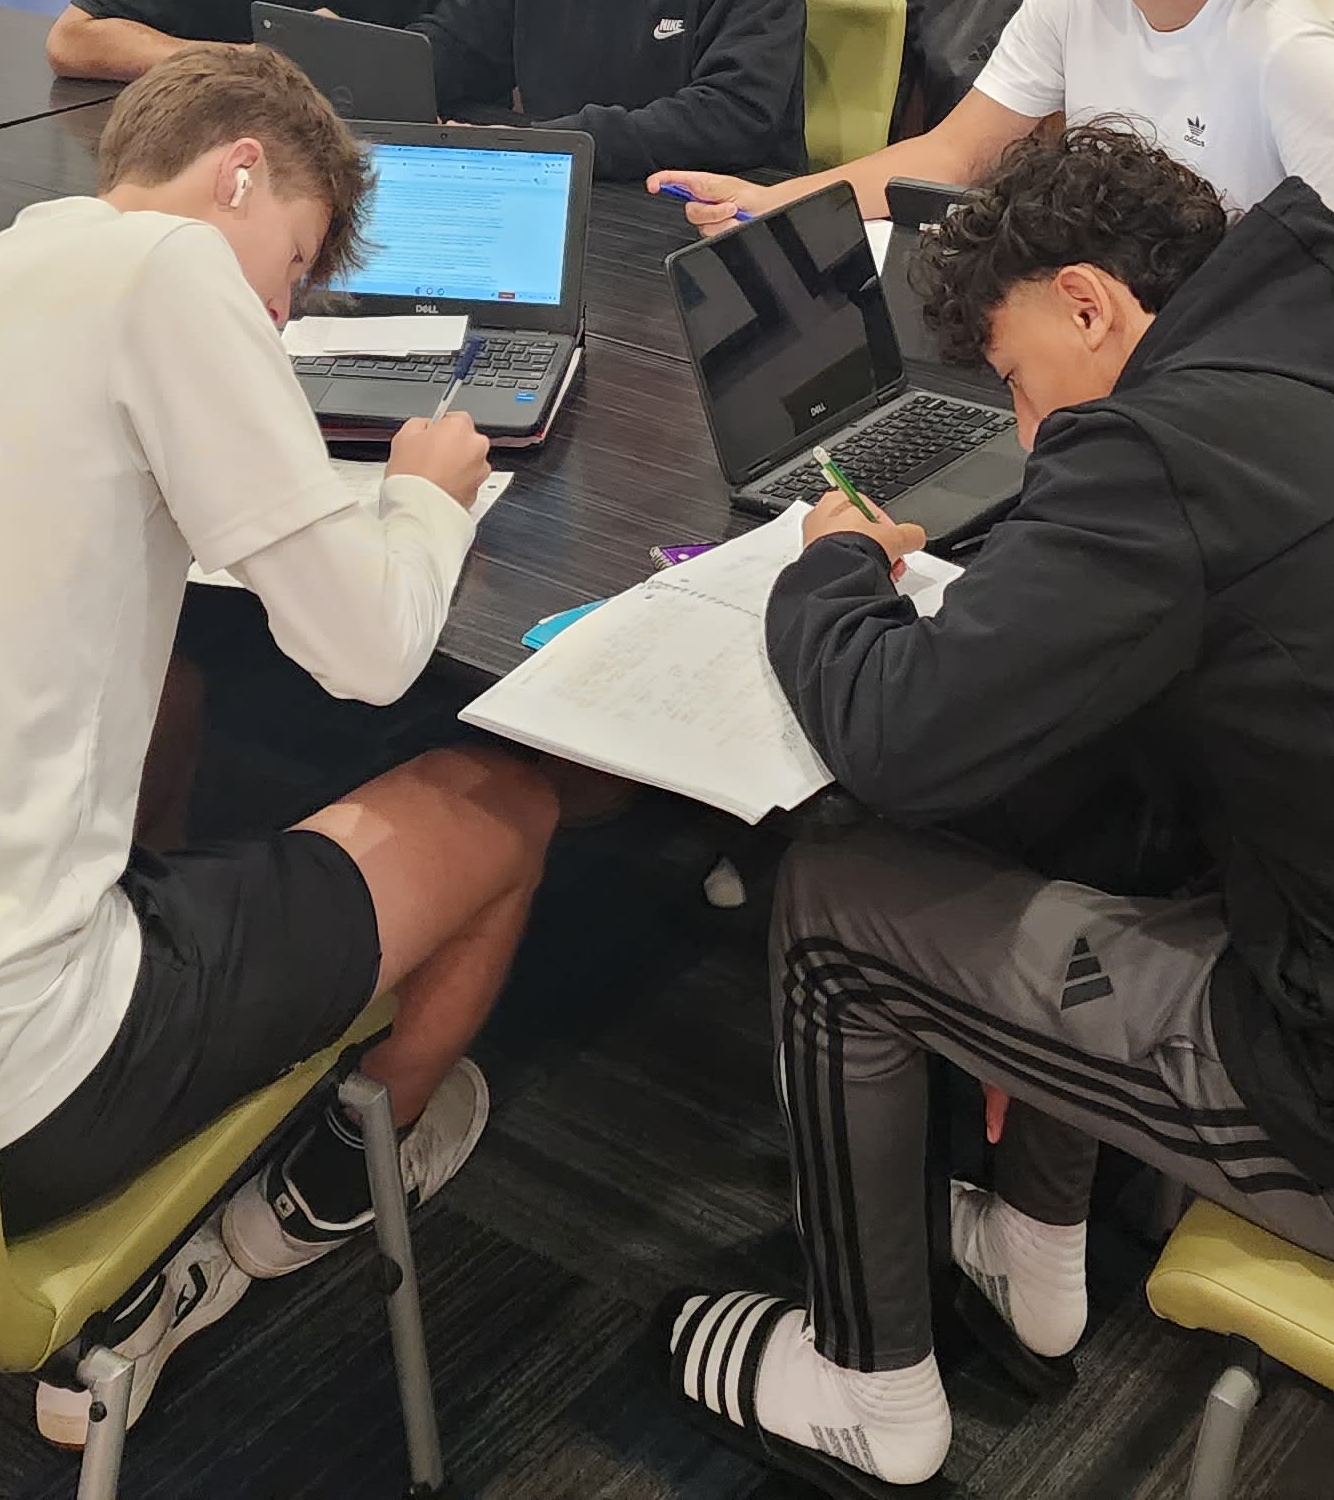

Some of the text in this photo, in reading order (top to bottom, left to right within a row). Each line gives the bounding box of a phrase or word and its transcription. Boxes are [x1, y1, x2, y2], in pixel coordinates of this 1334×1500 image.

[659, 18, 684, 31] NIKE
[415, 304, 439, 314] DELL
[810, 402, 827, 417] DELL
